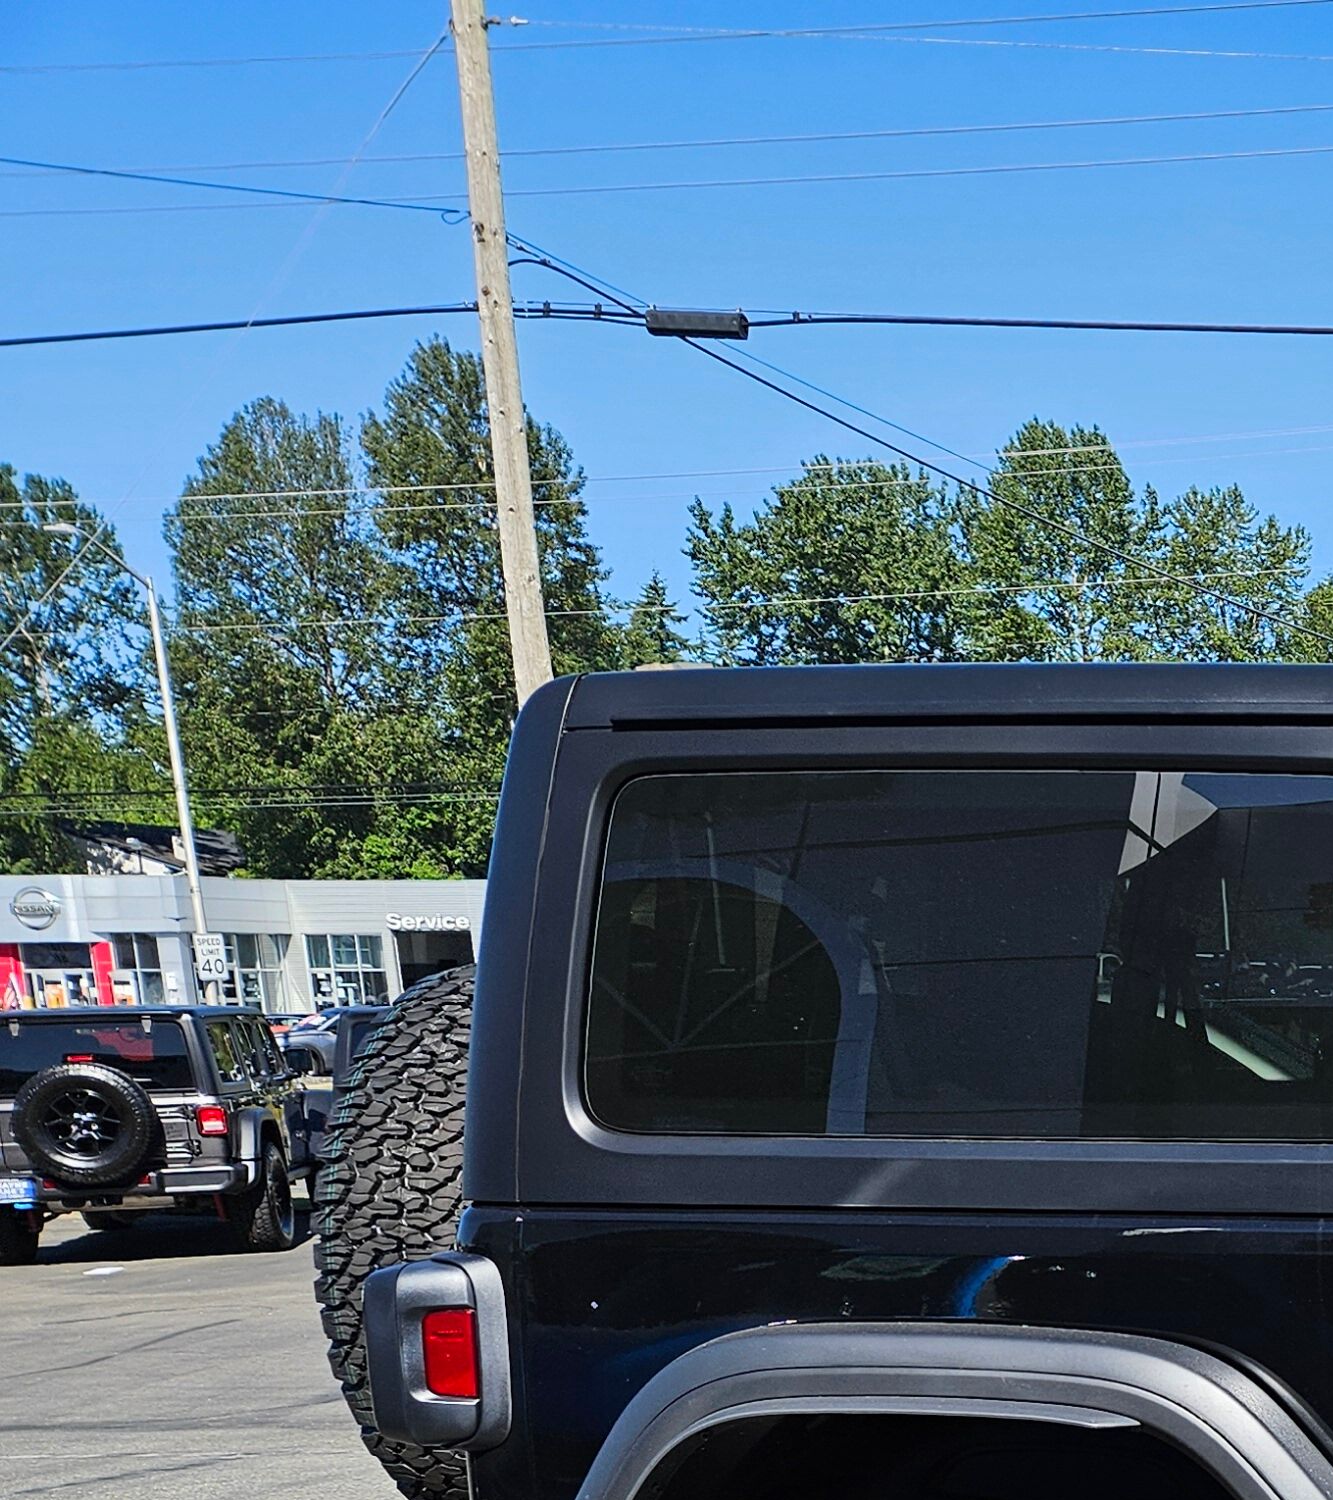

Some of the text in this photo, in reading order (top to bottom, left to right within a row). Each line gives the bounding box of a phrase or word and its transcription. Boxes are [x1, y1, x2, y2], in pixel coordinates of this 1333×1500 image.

[385, 912, 471, 930] Service
[197, 938, 220, 946] SPEED
[202, 958, 224, 974] 40
